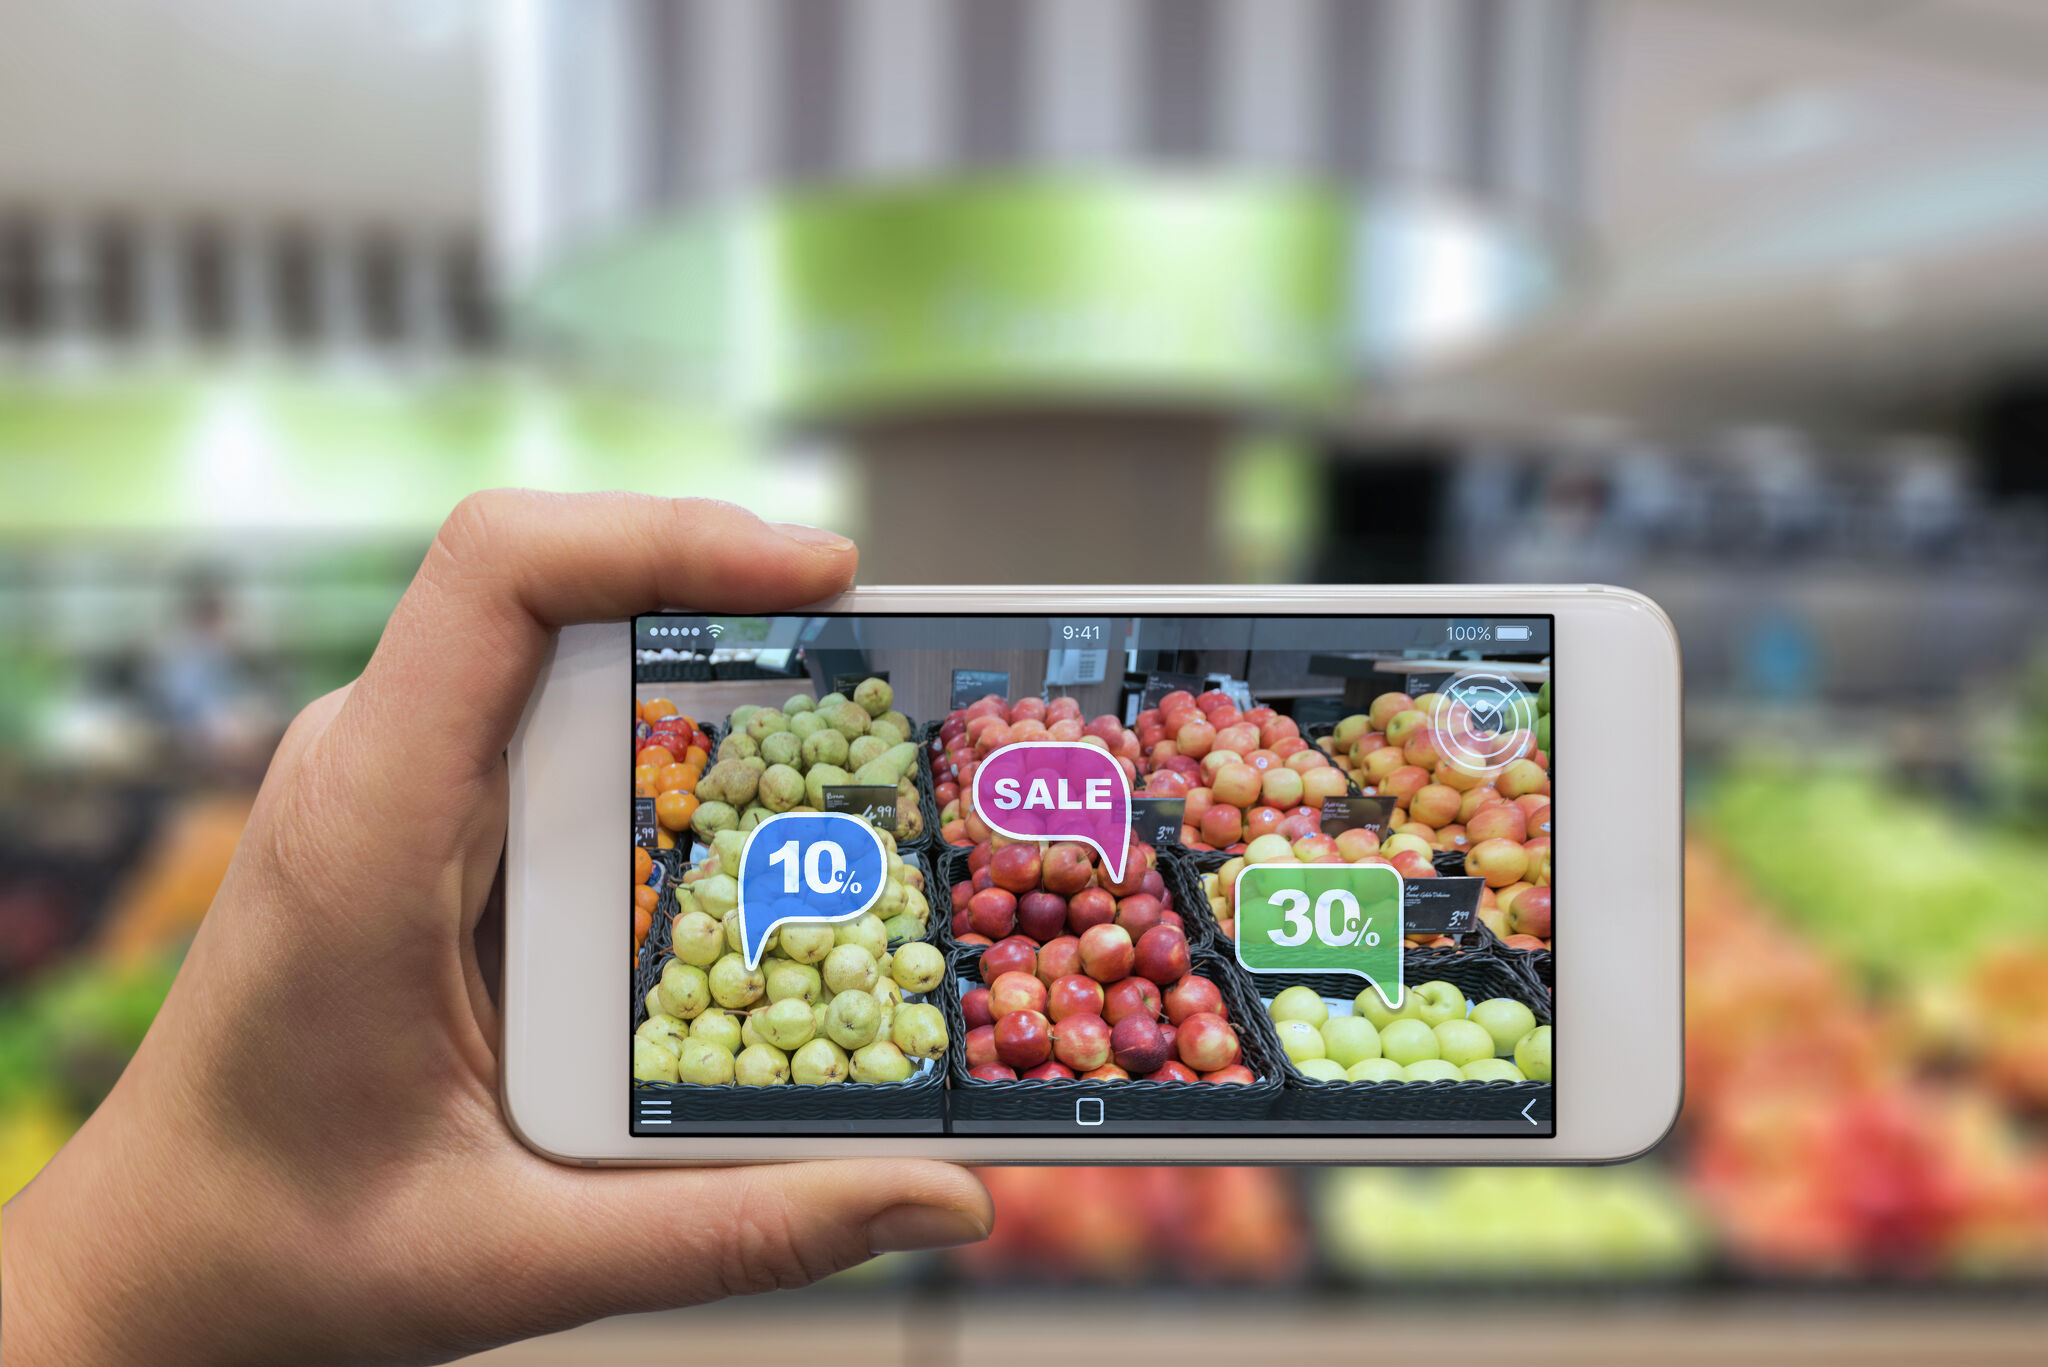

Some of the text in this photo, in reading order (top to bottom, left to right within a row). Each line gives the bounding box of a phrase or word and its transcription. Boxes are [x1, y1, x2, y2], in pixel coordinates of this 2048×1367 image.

[1063, 625, 1099, 640] 9:41
[1446, 626, 1491, 641] 100%
[993, 778, 1112, 810] SALE
[769, 840, 863, 894] 10%
[1266, 888, 1380, 947] 30%
[1448, 910, 1470, 927] 3.99
